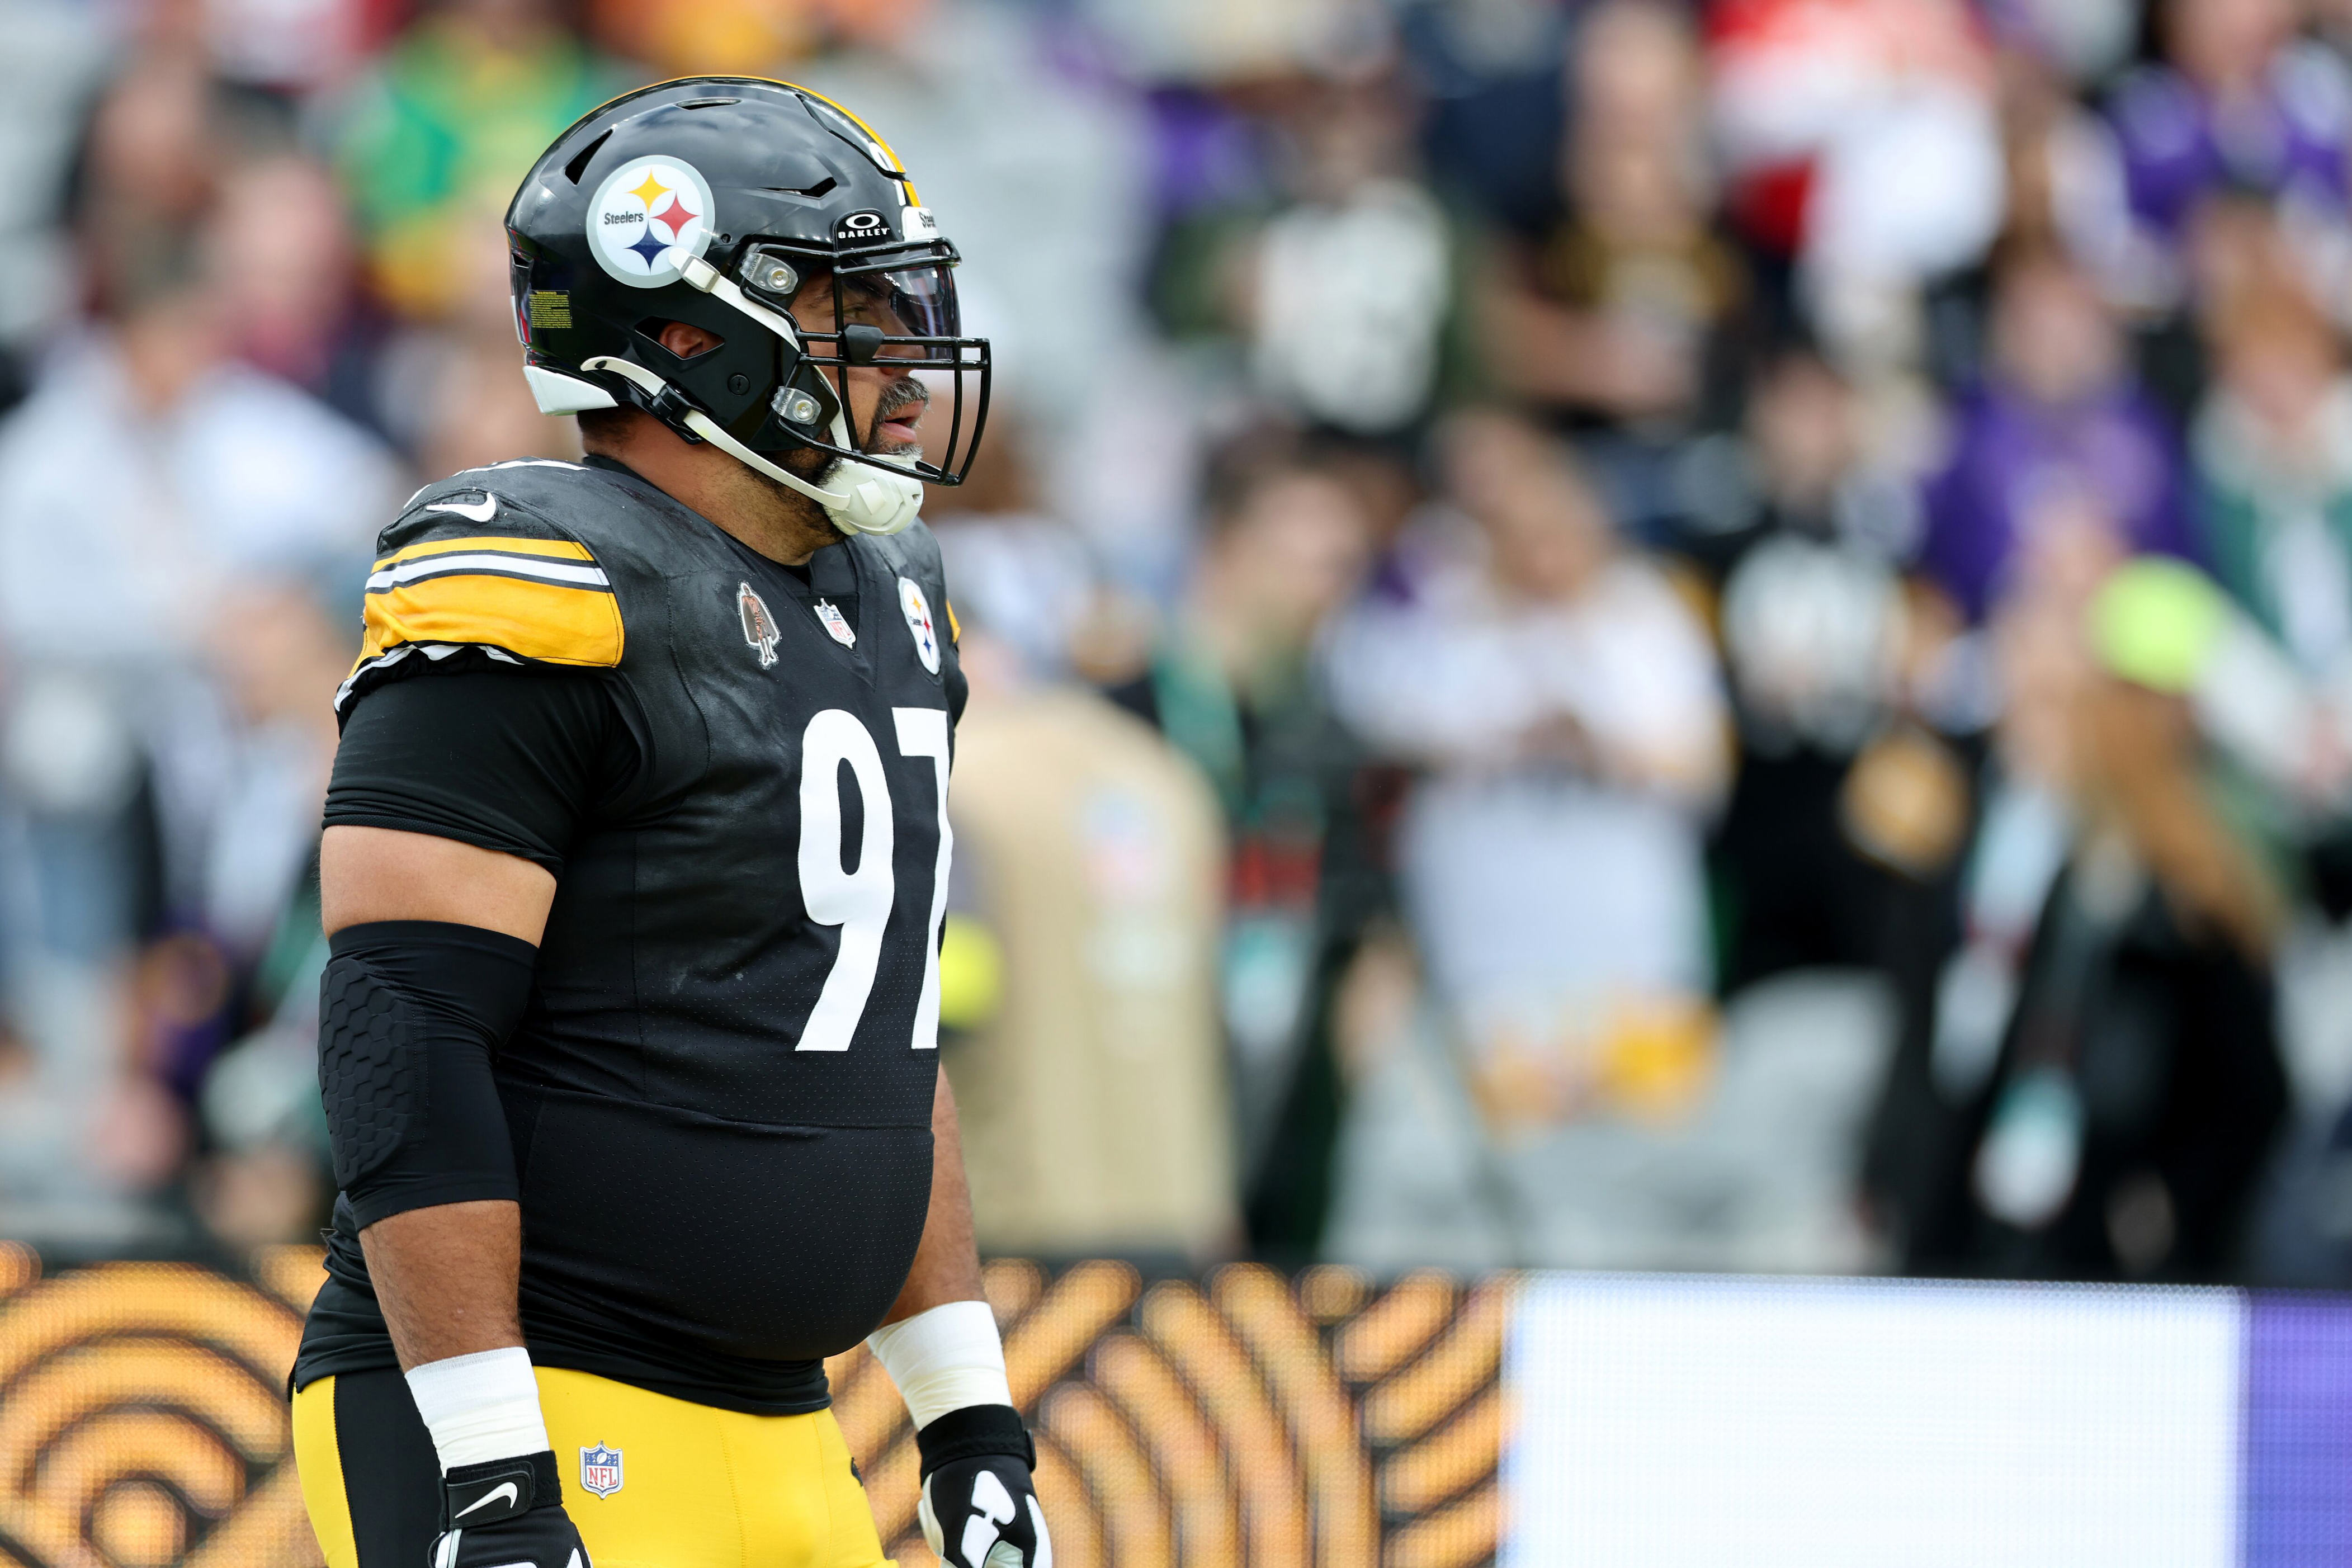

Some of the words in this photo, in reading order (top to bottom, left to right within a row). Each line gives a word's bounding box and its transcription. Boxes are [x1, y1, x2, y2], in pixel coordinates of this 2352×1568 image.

[604, 211, 644, 225] Steelers
[838, 228, 888, 239] OAKLEY
[795, 707, 953, 1051] 97
[588, 1467, 617, 1487] NFL
